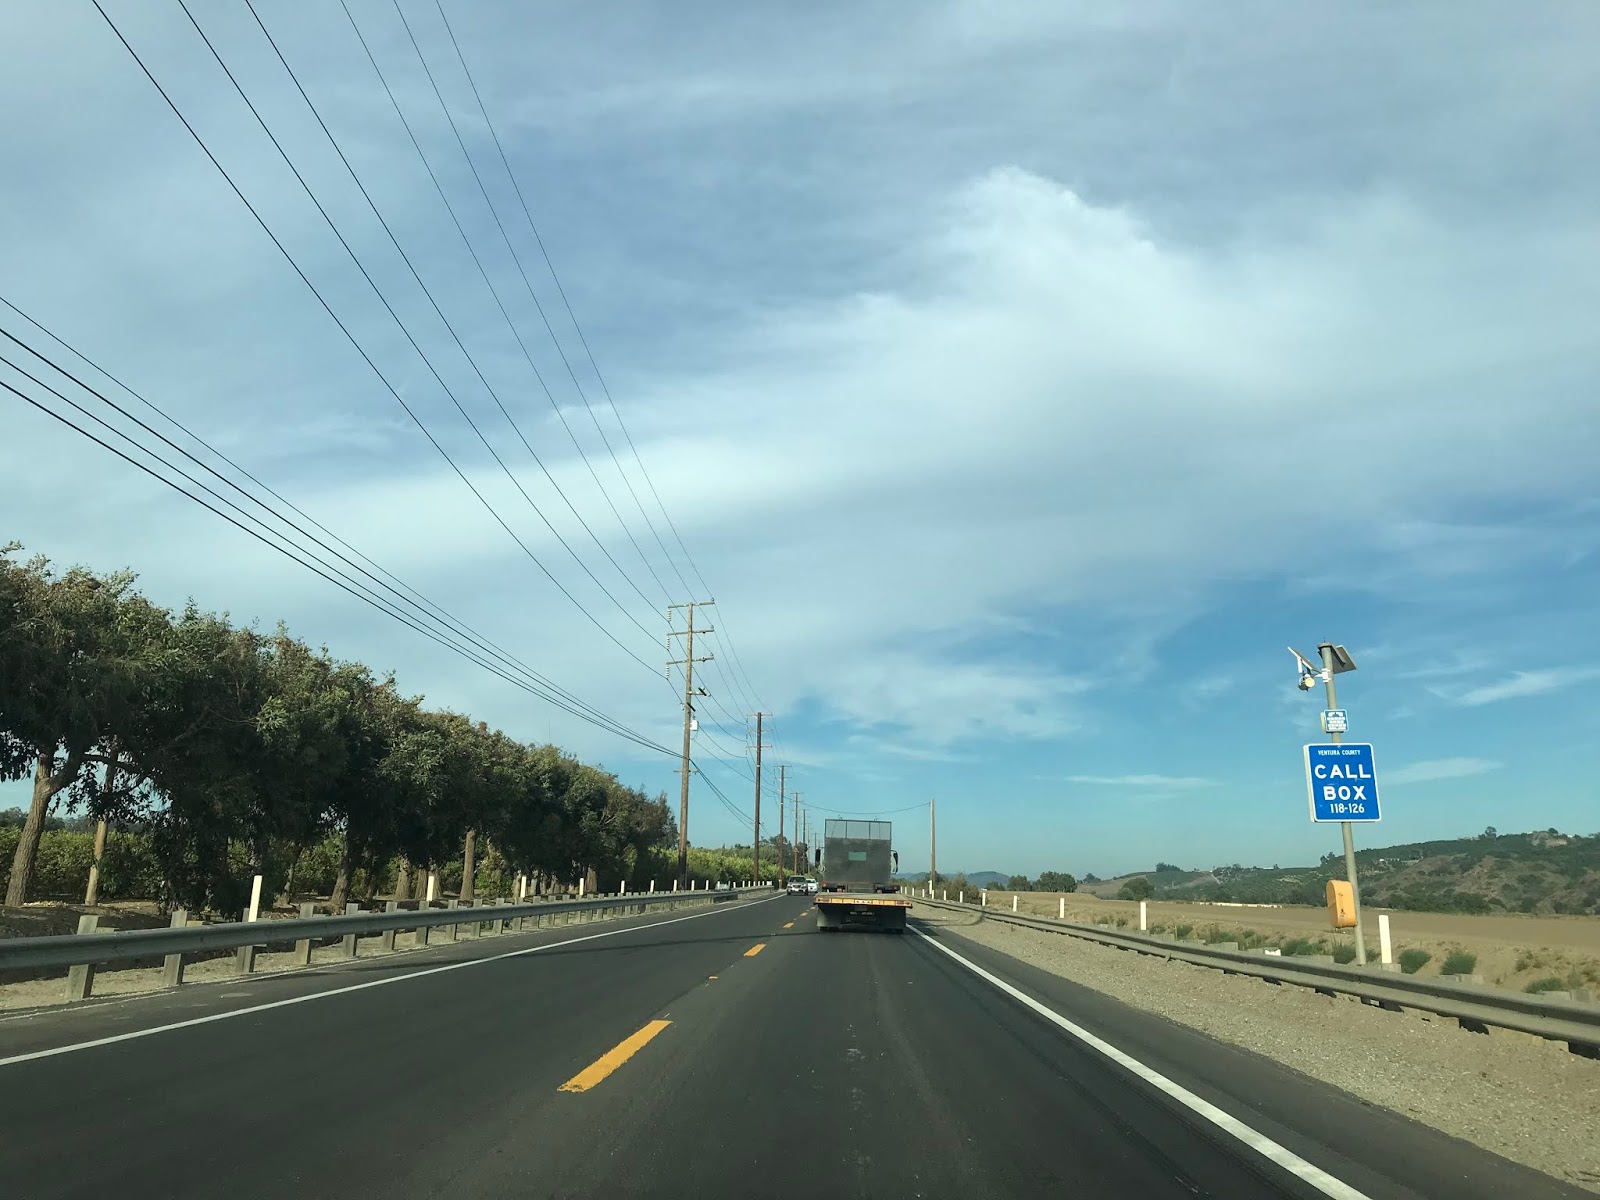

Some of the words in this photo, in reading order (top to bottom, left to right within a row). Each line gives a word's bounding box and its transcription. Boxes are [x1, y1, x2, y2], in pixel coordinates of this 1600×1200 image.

[1314, 764, 1371, 779] CALL
[1323, 786, 1366, 800] BOX
[1330, 803, 1365, 814] 118-126
